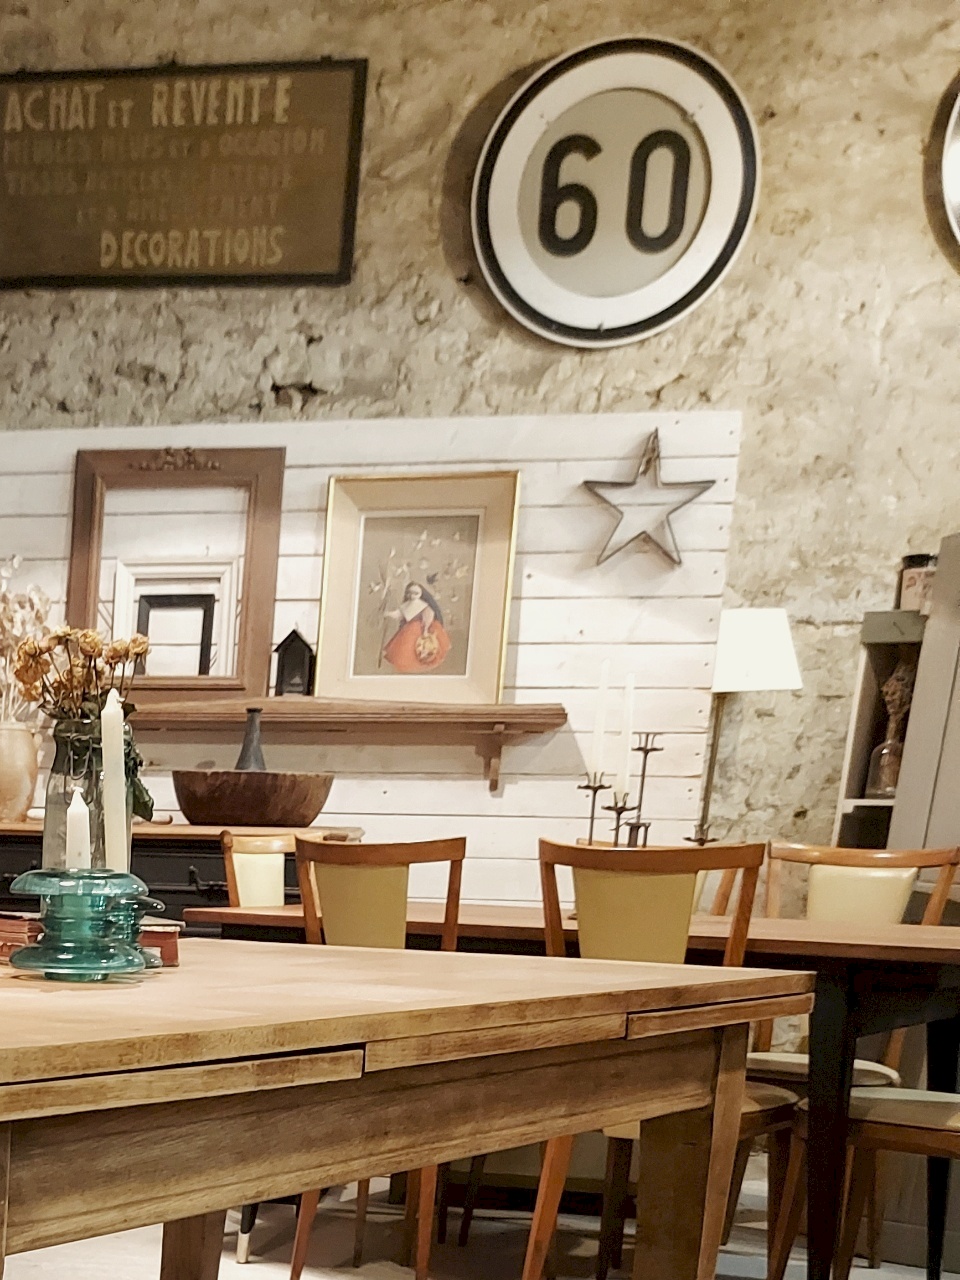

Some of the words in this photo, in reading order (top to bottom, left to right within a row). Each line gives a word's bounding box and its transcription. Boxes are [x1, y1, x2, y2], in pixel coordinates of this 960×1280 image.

[4, 84, 104, 132] ACHAT
[151, 76, 293, 127] REVENTE
[537, 128, 692, 258] 60
[99, 225, 287, 269] DECORATIONS
